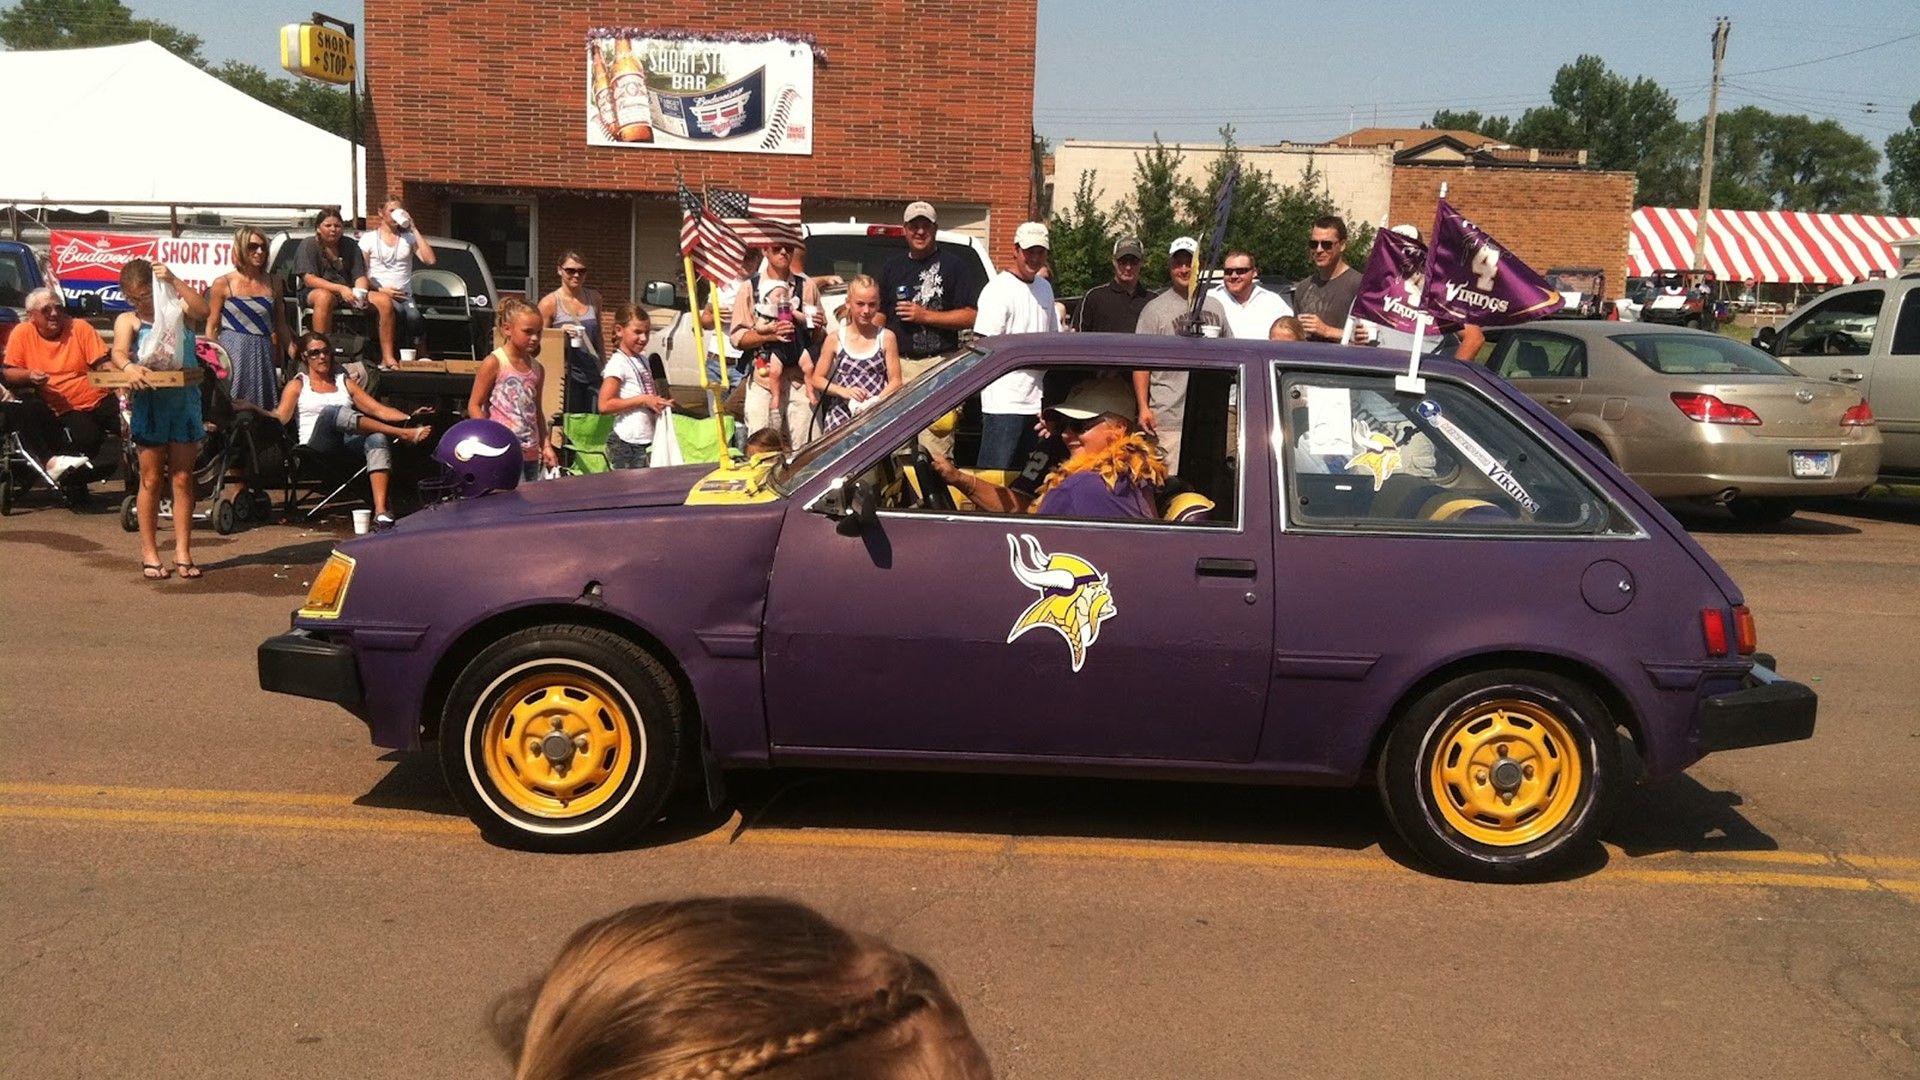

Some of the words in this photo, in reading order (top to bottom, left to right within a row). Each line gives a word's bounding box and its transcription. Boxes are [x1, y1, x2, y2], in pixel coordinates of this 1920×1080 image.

[317, 31, 350, 54] SHORT
[323, 51, 347, 76] STOP
[649, 48, 696, 74] SHORT
[702, 50, 728, 75] STO
[672, 75, 707, 90] BAR
[162, 241, 210, 265] SHORT
[214, 243, 238, 266] ST
[1471, 246, 1501, 291] 4
[1383, 294, 1435, 326] VIKINS
